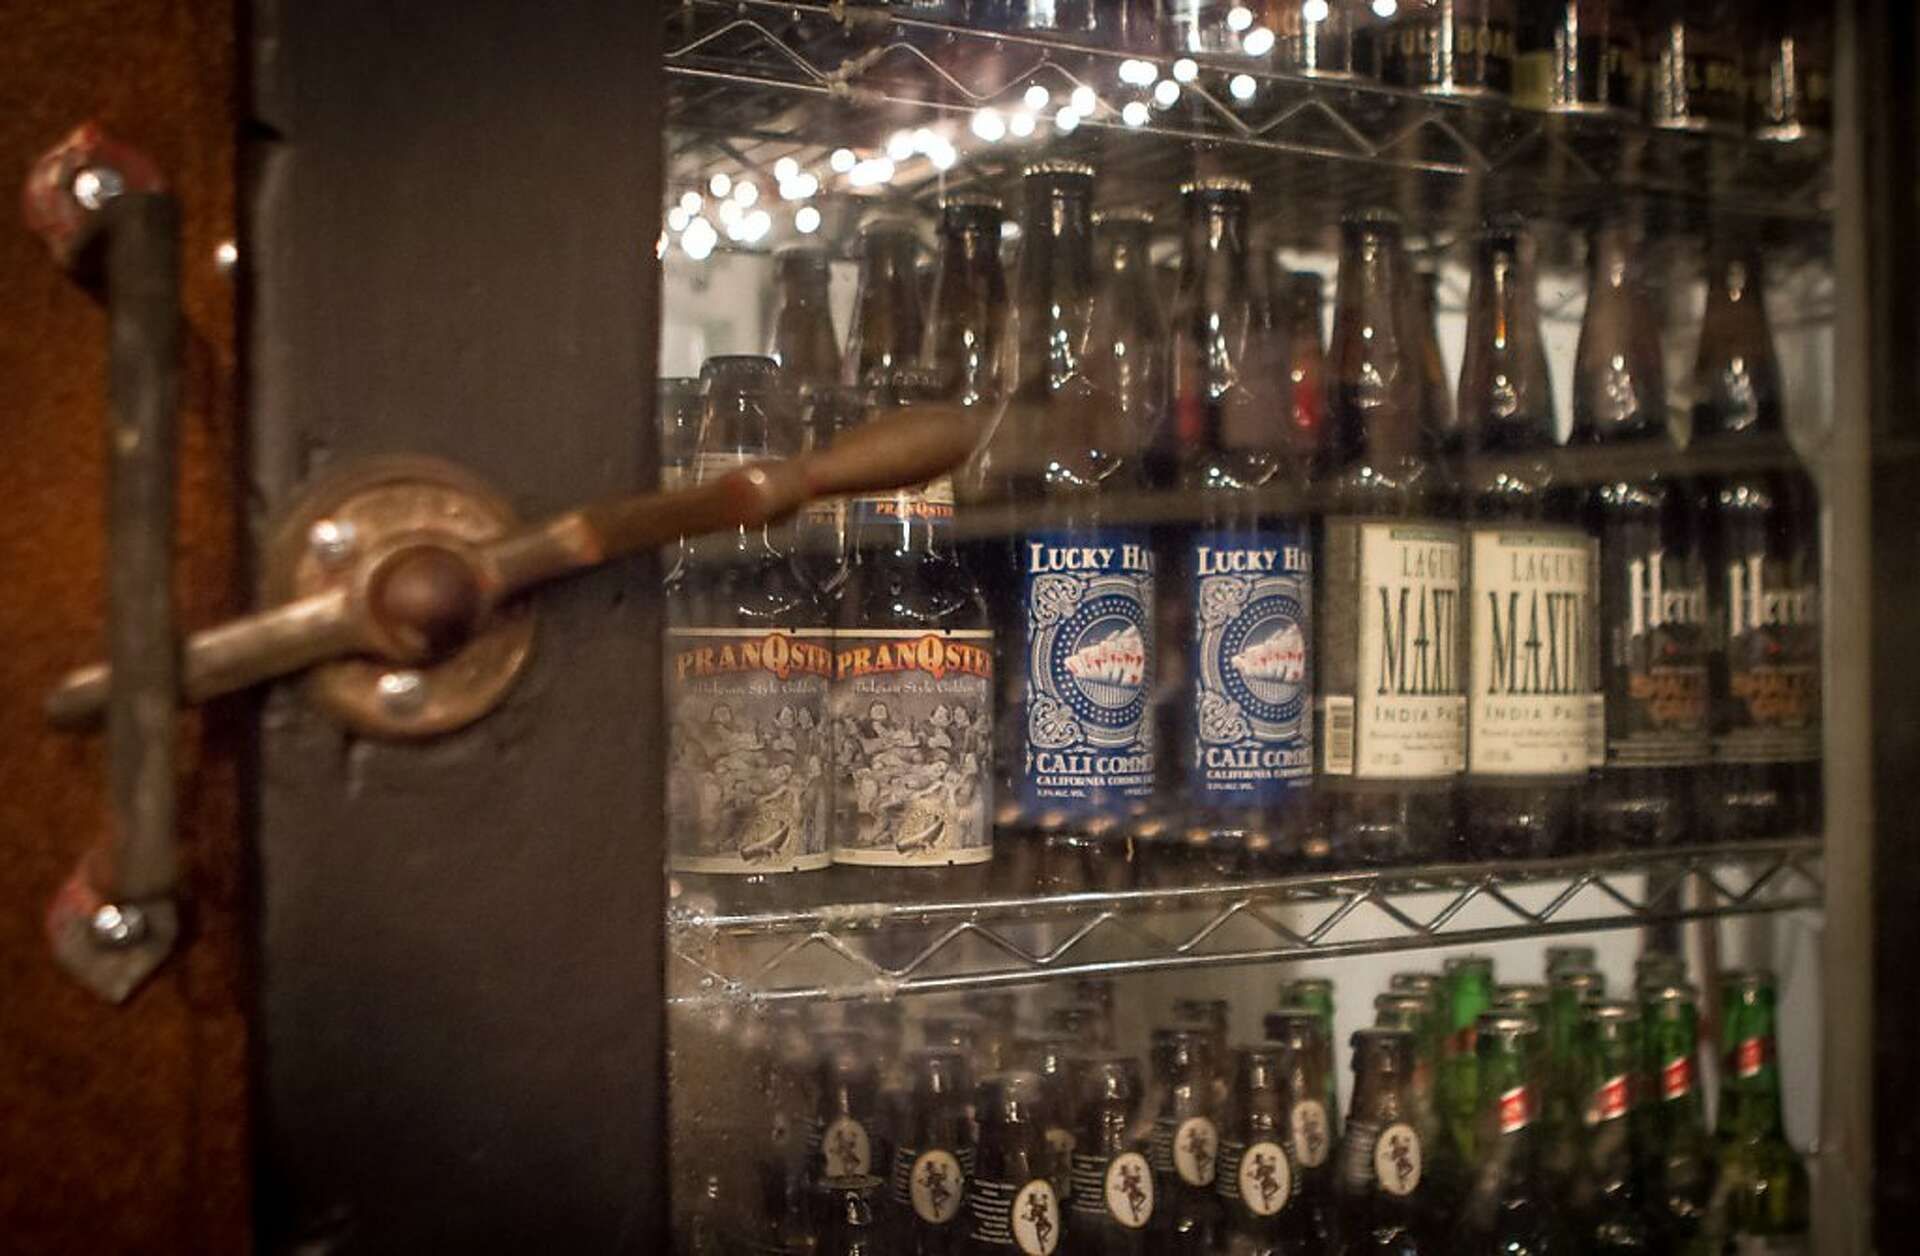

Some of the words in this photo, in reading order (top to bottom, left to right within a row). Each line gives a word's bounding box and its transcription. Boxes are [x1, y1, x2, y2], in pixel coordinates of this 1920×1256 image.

[1029, 544, 1115, 573] LUCKY
[1197, 547, 1278, 575] LUCKY
[1036, 752, 1092, 774] CALI
[1206, 747, 1260, 768] CALI
